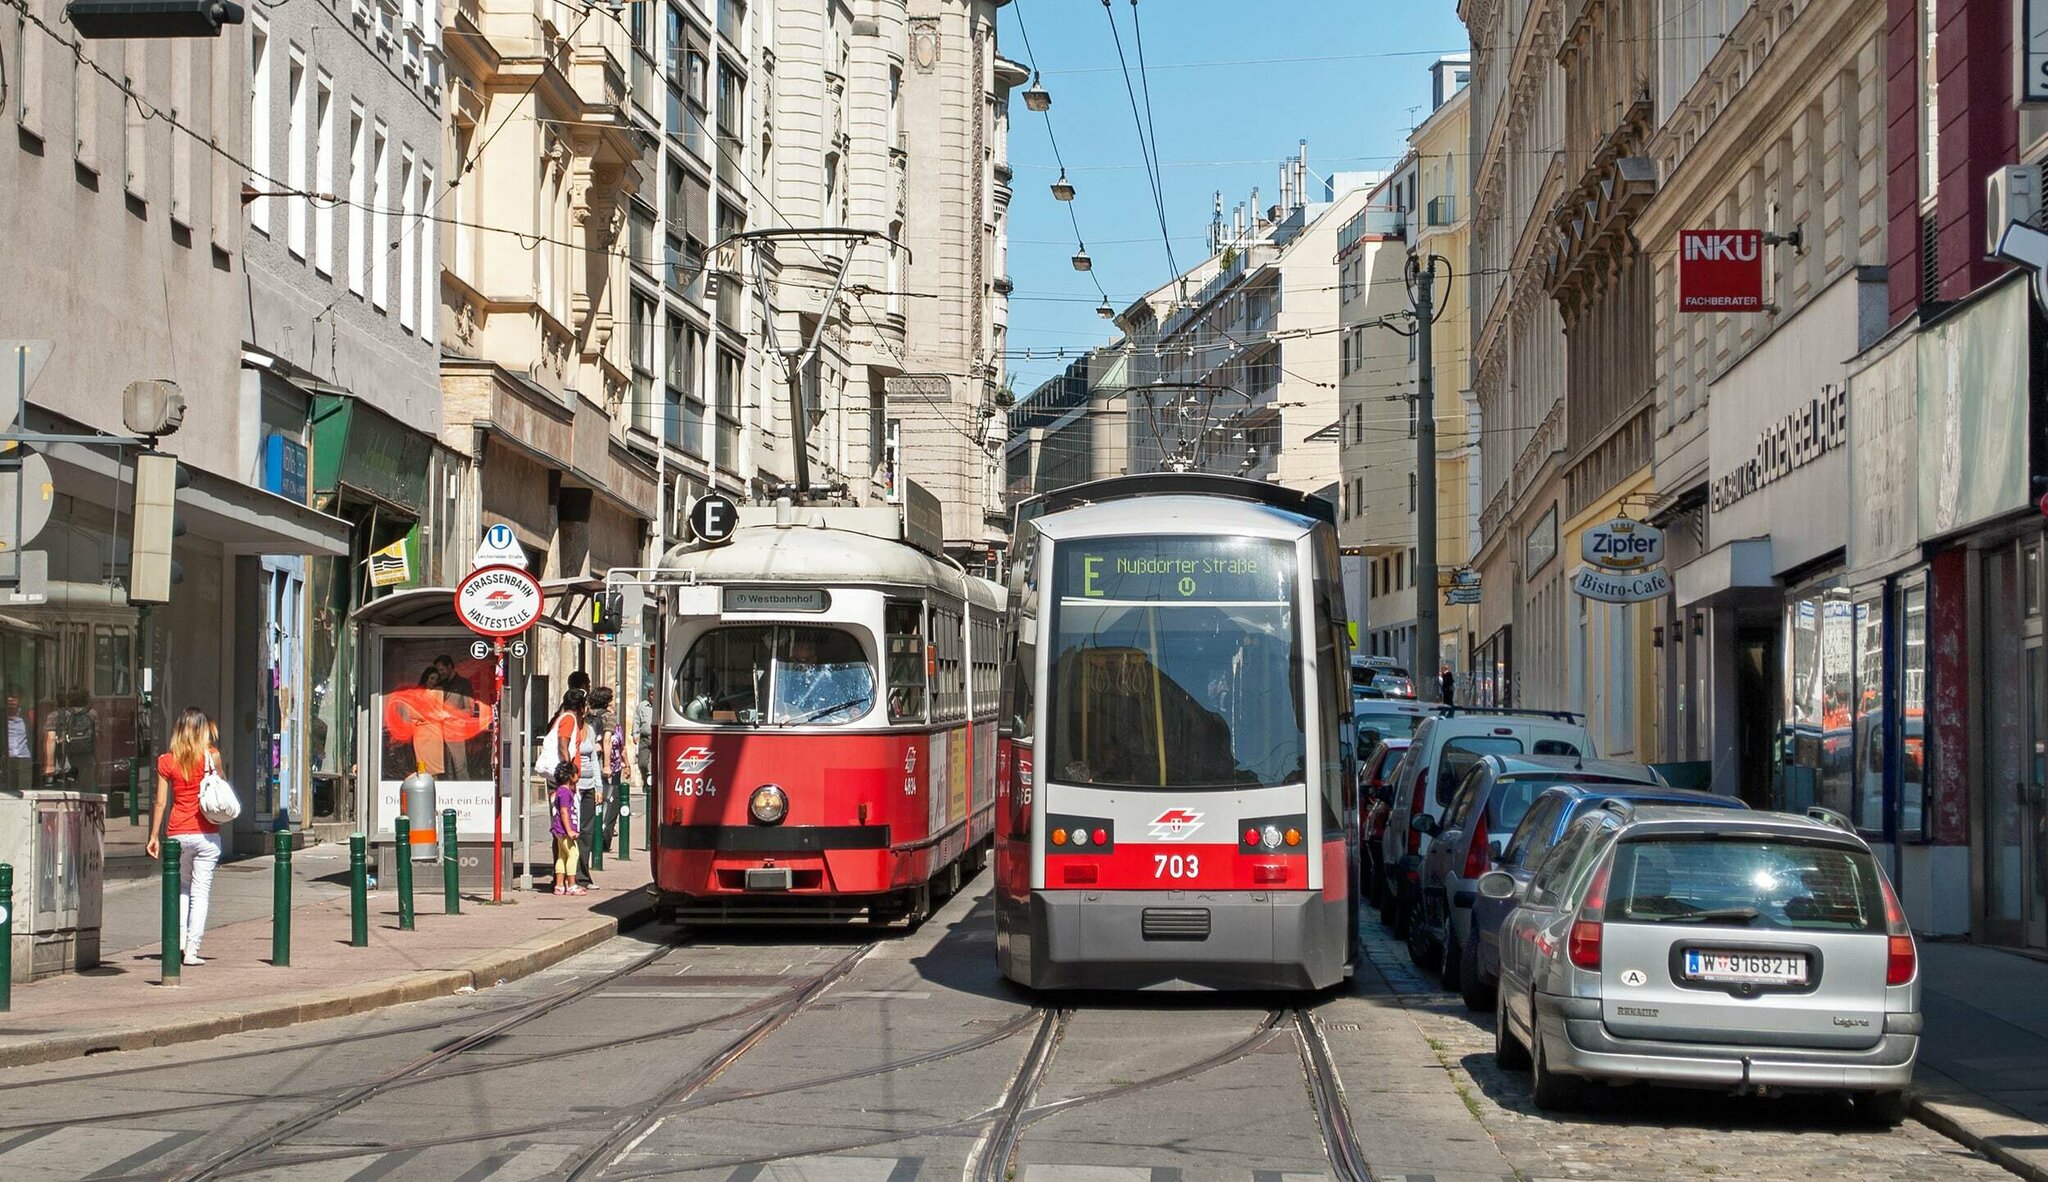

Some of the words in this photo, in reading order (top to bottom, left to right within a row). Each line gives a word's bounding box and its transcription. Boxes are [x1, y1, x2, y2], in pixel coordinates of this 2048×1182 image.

[1685, 235, 1757, 261] INKU
[1685, 297, 1757, 306] FACHBERATER
[705, 501, 724, 537] E
[1593, 533, 1657, 557] Zipfer
[1084, 556, 1104, 596] E
[1202, 557, 1257, 575] Straße
[465, 573, 534, 597] STRASSENBAHN
[748, 594, 813, 603] Westbahnhof
[467, 608, 531, 629] HALTESTELLE
[477, 644, 485, 657] E
[515, 643, 524, 656] 5
[674, 777, 717, 796] 4834
[438, 795, 454, 805] hat
[457, 796, 473, 805] ein
[475, 795, 494, 805] End
[1154, 854, 1199, 878] 703
[1703, 954, 1715, 971] W
[1730, 955, 1783, 975] 91682
[1787, 957, 1798, 975] H
[1628, 972, 1640, 983] A
